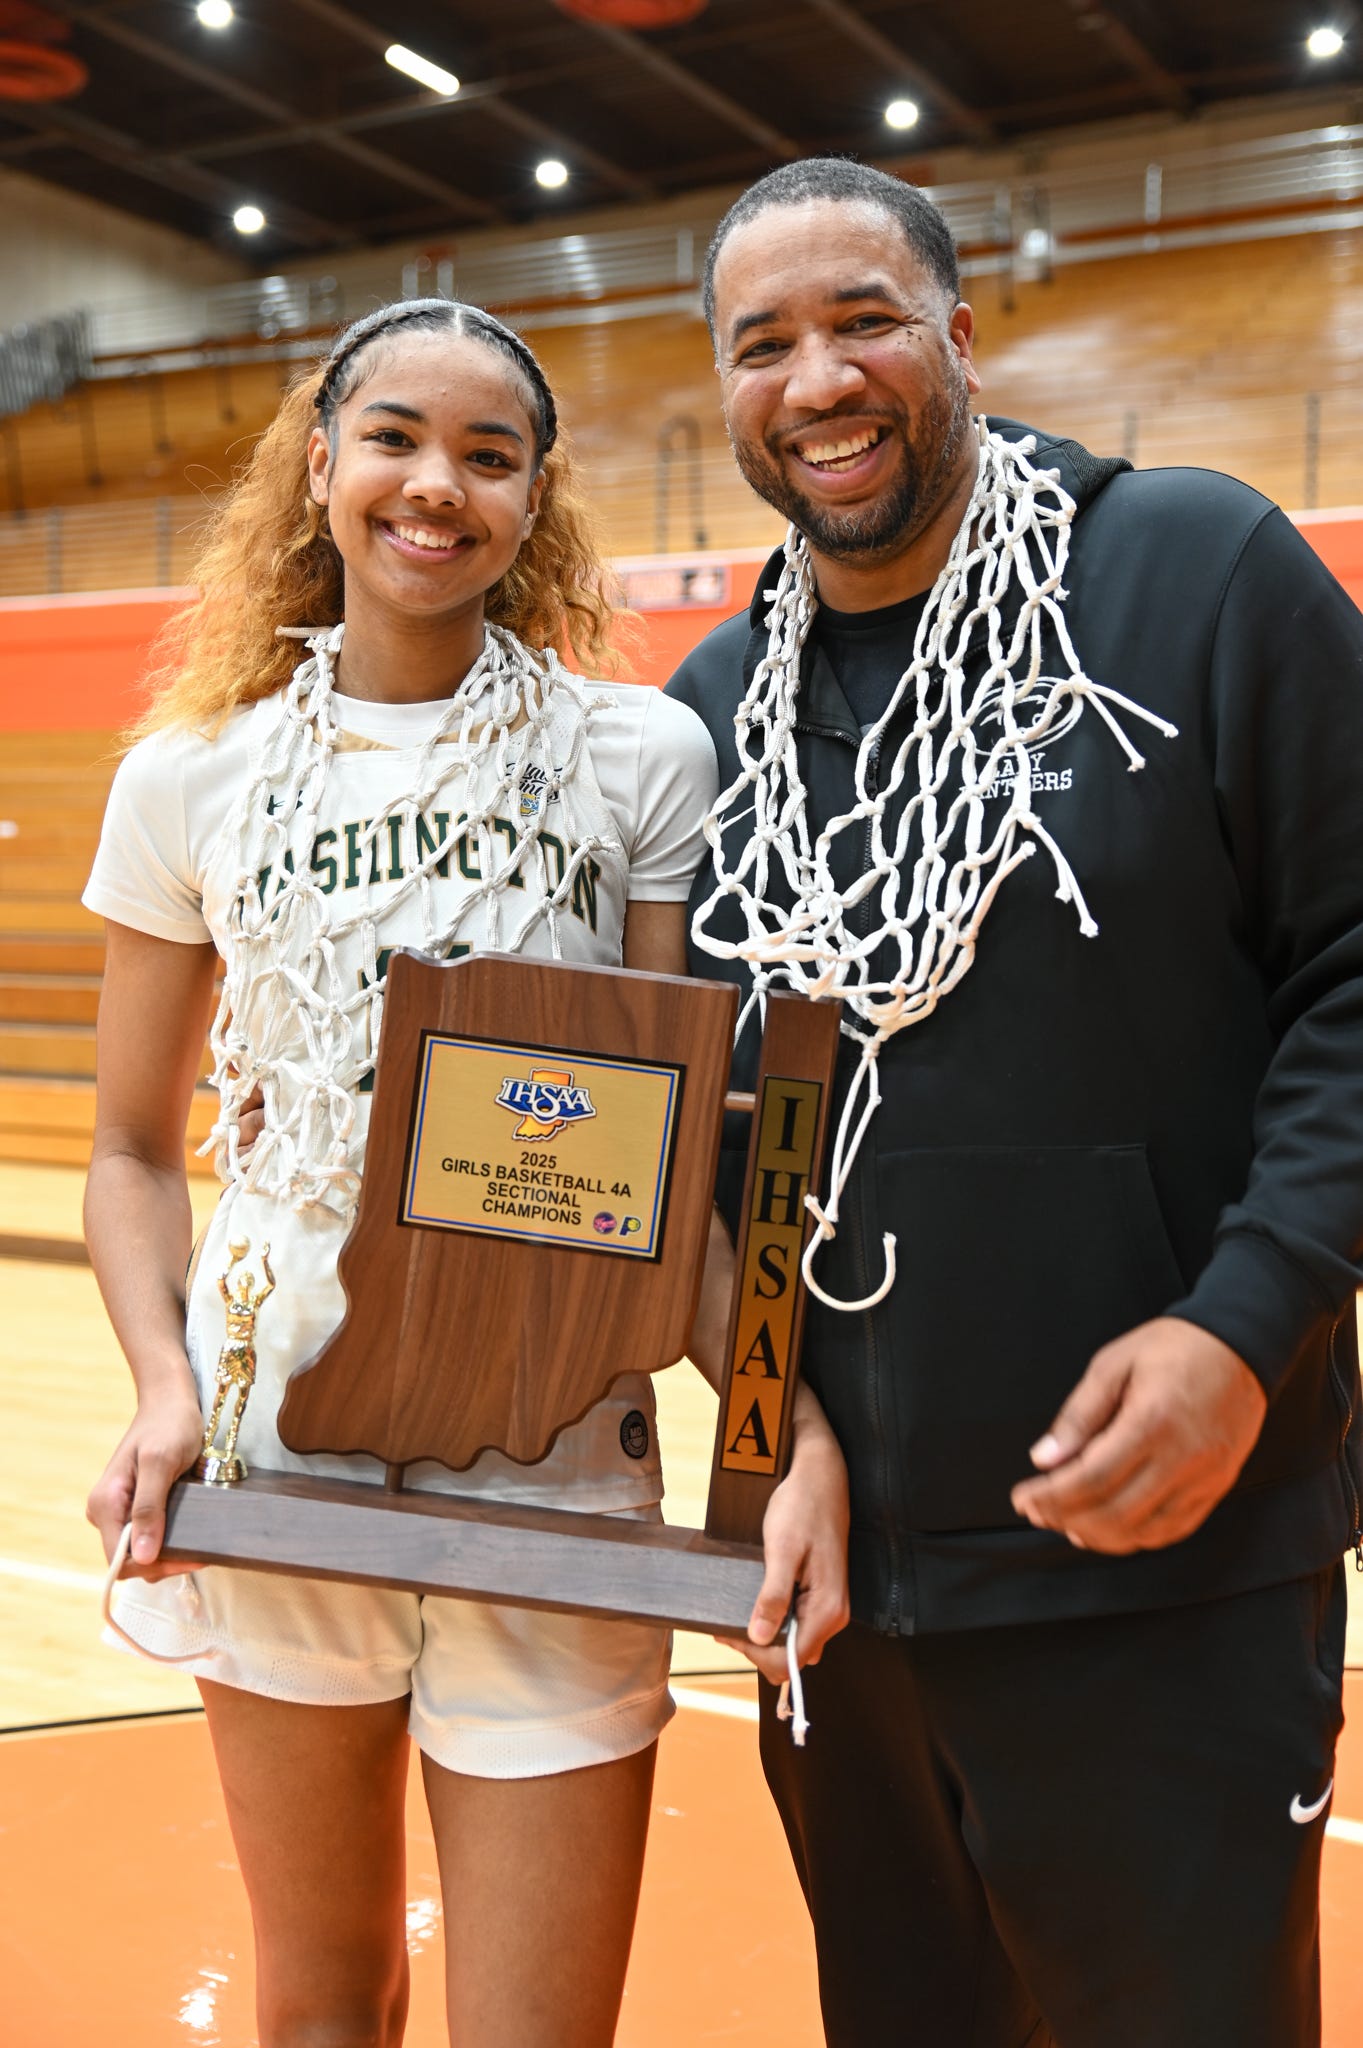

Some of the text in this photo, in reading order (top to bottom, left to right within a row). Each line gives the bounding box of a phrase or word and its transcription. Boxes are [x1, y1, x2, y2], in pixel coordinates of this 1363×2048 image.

[994, 752, 1046, 778] AY
[959, 768, 1073, 800] NTERS
[501, 1080, 593, 1118] IHSAA
[520, 1151, 557, 1169] 2025
[441, 1157, 632, 1198] GIRLS BASKETBALL 4A
[487, 1182, 581, 1208] SECTIONAL
[482, 1198, 582, 1225] CHAMPIONS
[726, 1095, 808, 1459] IHSAA
